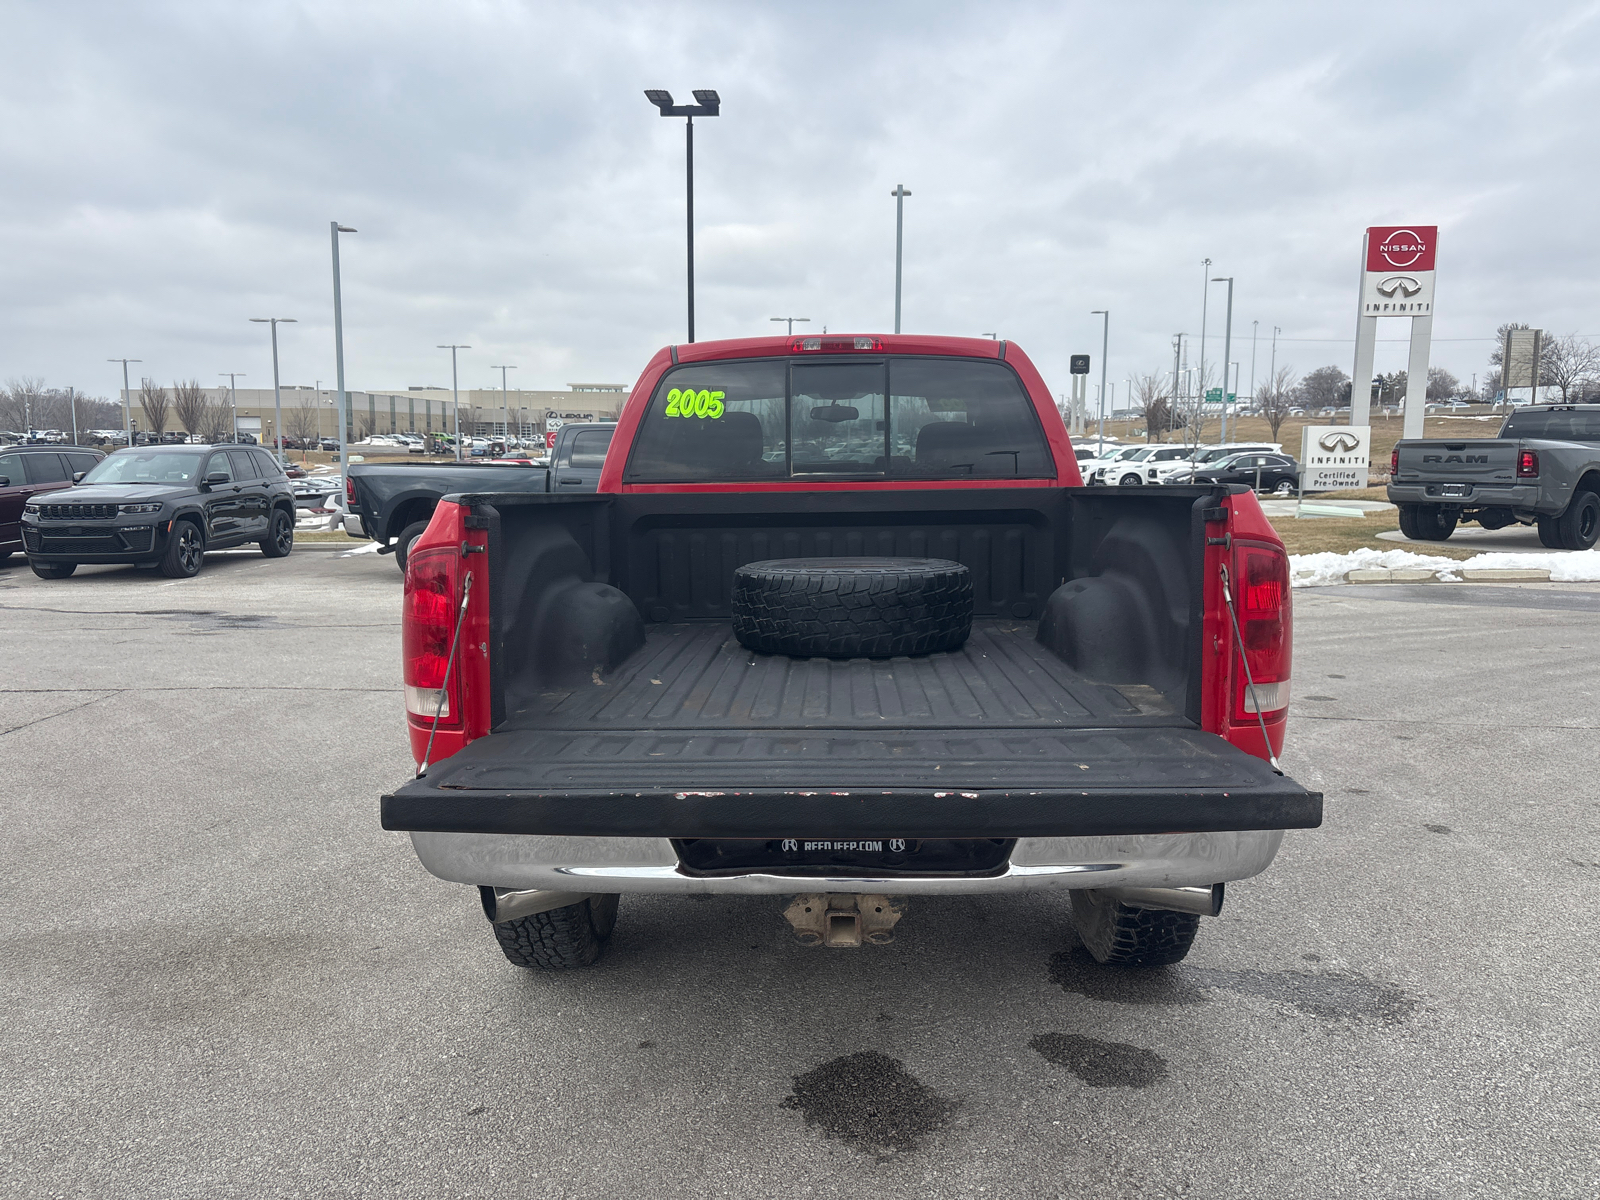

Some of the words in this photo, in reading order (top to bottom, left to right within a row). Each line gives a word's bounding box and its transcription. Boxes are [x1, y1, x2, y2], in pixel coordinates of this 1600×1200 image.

[1366, 303, 1430, 311] INFINITI
[665, 388, 725, 419] 2005
[1423, 455, 1488, 464] RAM
